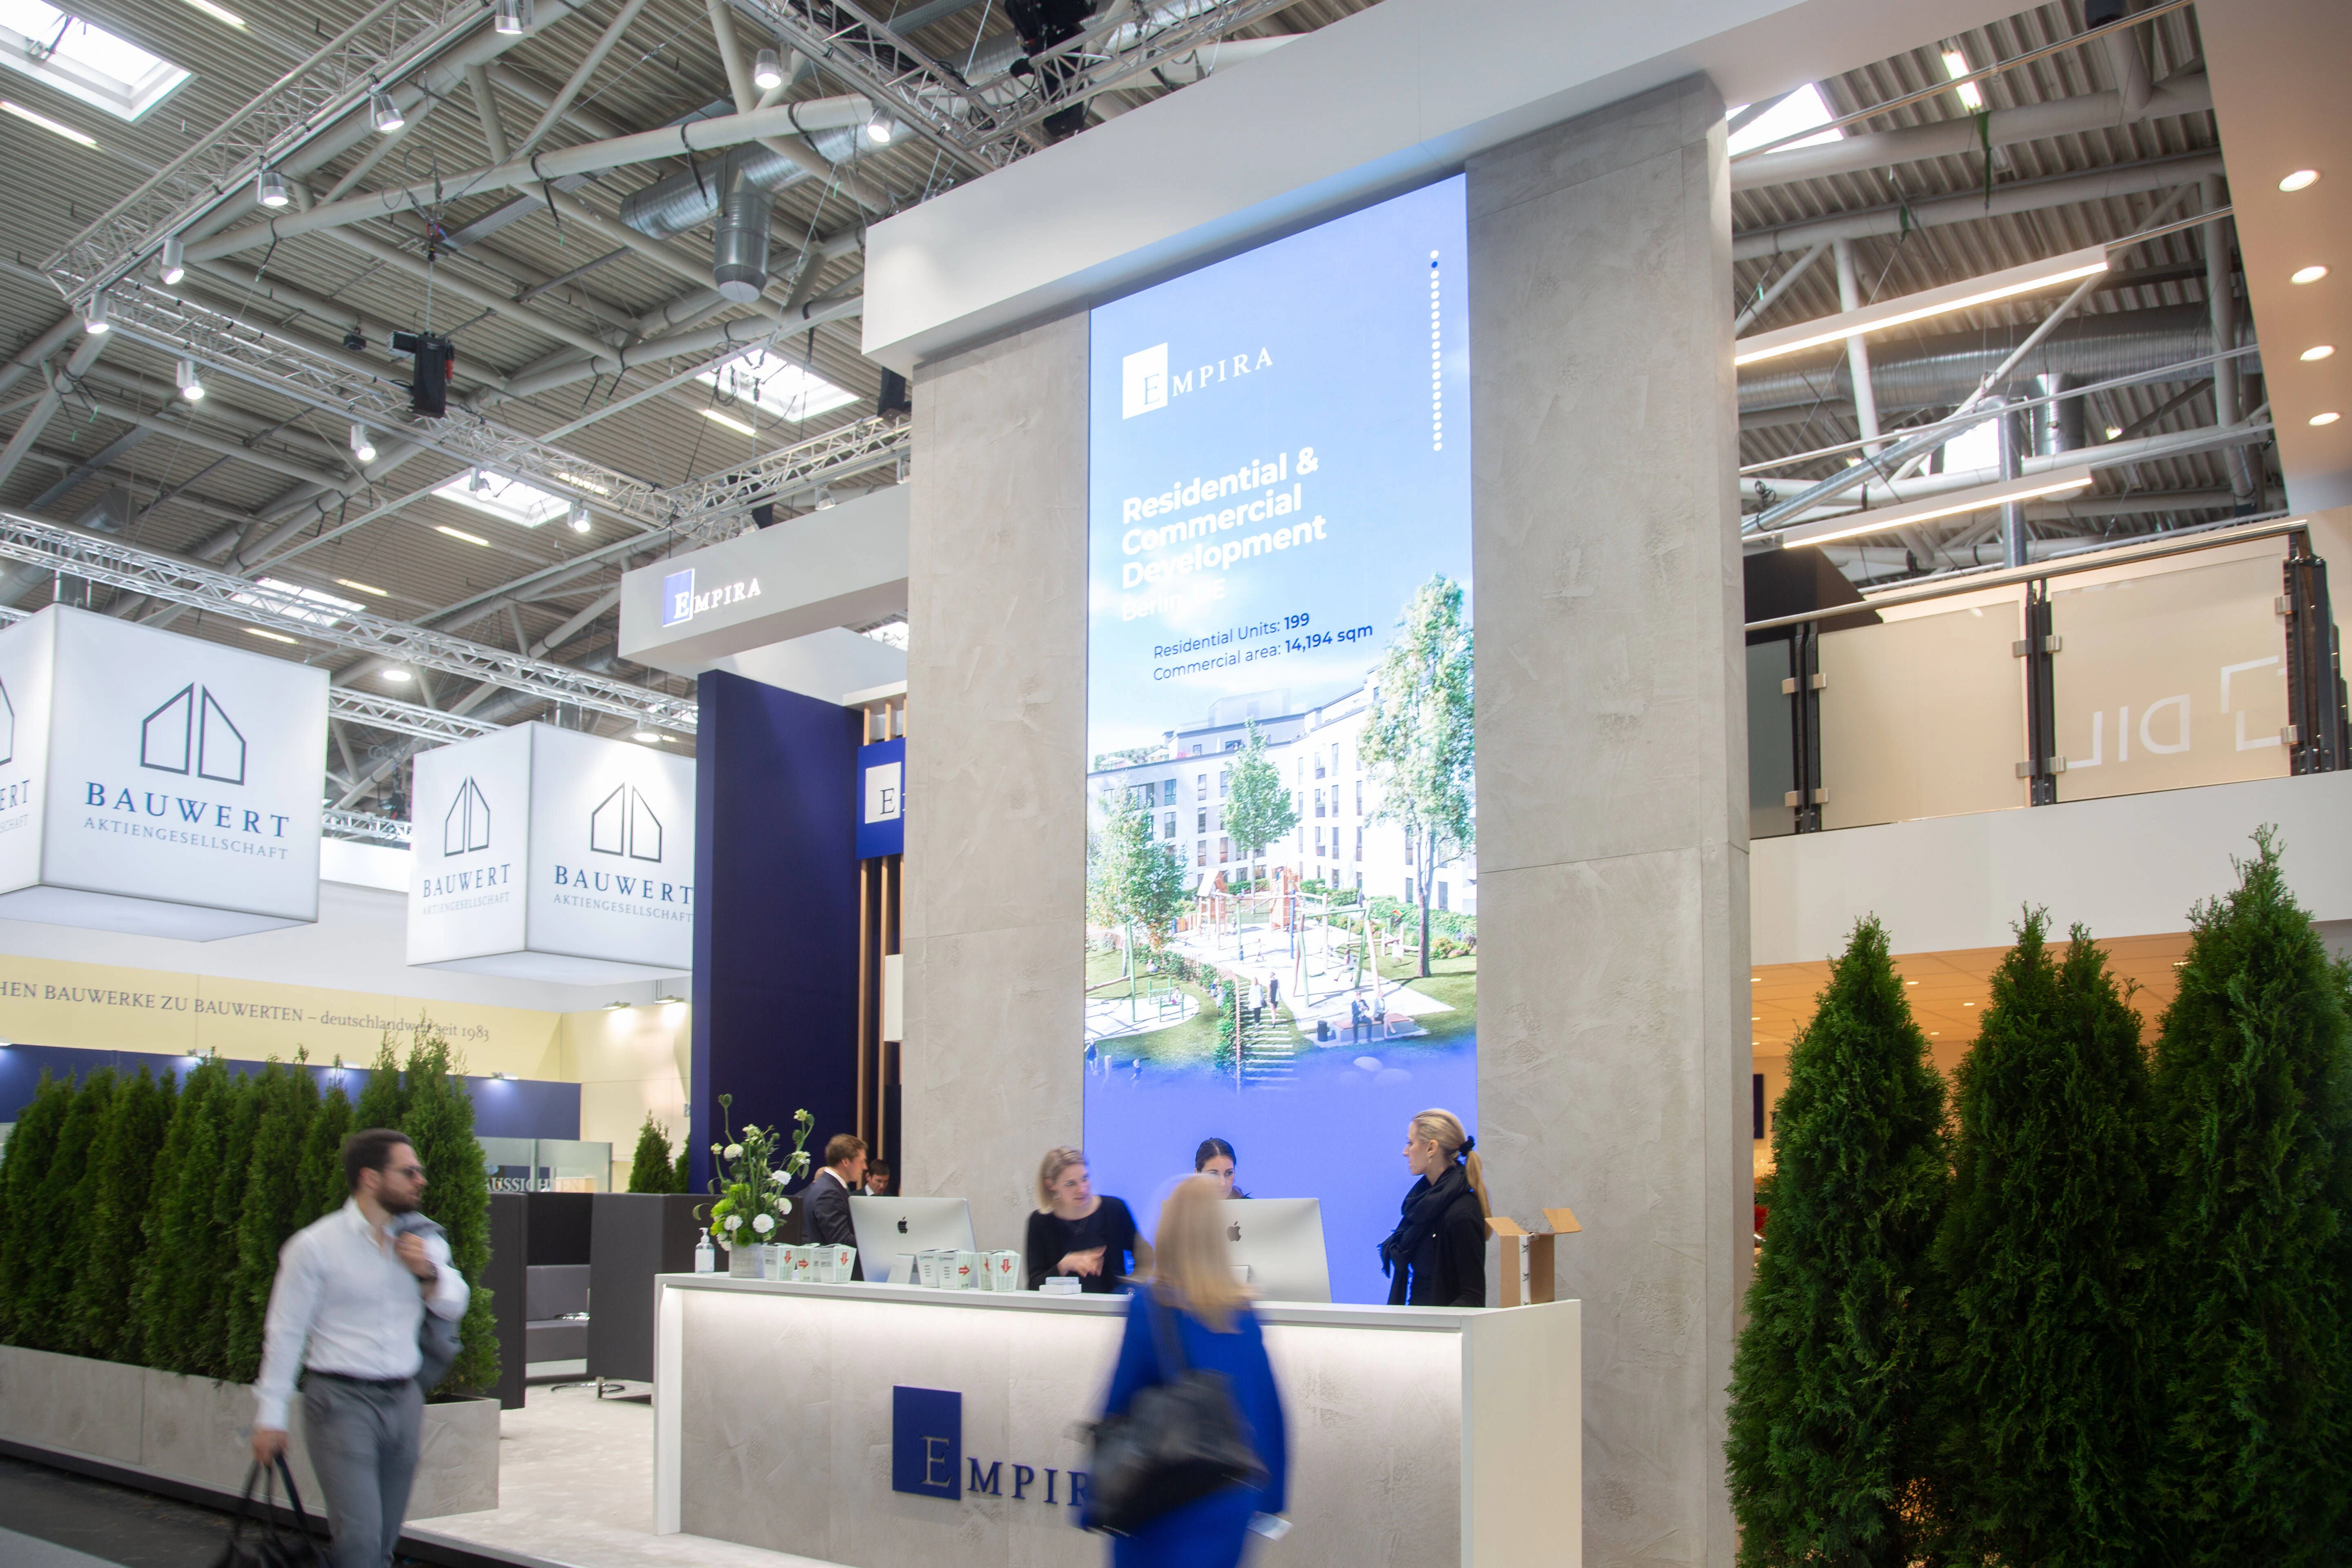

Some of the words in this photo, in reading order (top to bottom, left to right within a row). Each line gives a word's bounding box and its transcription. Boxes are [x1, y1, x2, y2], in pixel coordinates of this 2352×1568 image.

[1143, 347, 1273, 406] EMPIRA
[1123, 453, 1287, 524] Residential
[1296, 446, 1319, 474] &
[1122, 483, 1302, 555] Commercial
[1123, 514, 1327, 589] Development
[673, 578, 762, 619] EMPIRA
[1154, 629, 1233, 659] Residential
[1237, 619, 1280, 641] Units:
[1284, 612, 1310, 630] 199
[1154, 650, 1241, 681] Commercial
[1245, 642, 1281, 662] area:
[1285, 631, 1332, 655] 14,194
[1337, 623, 1373, 648] sqm
[85, 782, 290, 838] BAUWERT
[83, 817, 288, 860] AKTIENGESELLSCHAFT
[422, 892, 510, 915] AKTIENGESELLSCHAFT
[423, 863, 511, 898] BAUWERT
[553, 893, 693, 923] AKTIENGESELLSCHAFT
[554, 865, 693, 905] BAUWERT
[44, 985, 156, 1008] BAUWERKE
[161, 995, 188, 1011] ZU
[194, 998, 303, 1022] BAUWERTEN
[435, 1022, 457, 1036] seit
[462, 1025, 490, 1042] 1983
[920, 1435, 1088, 1506] EMPIR
